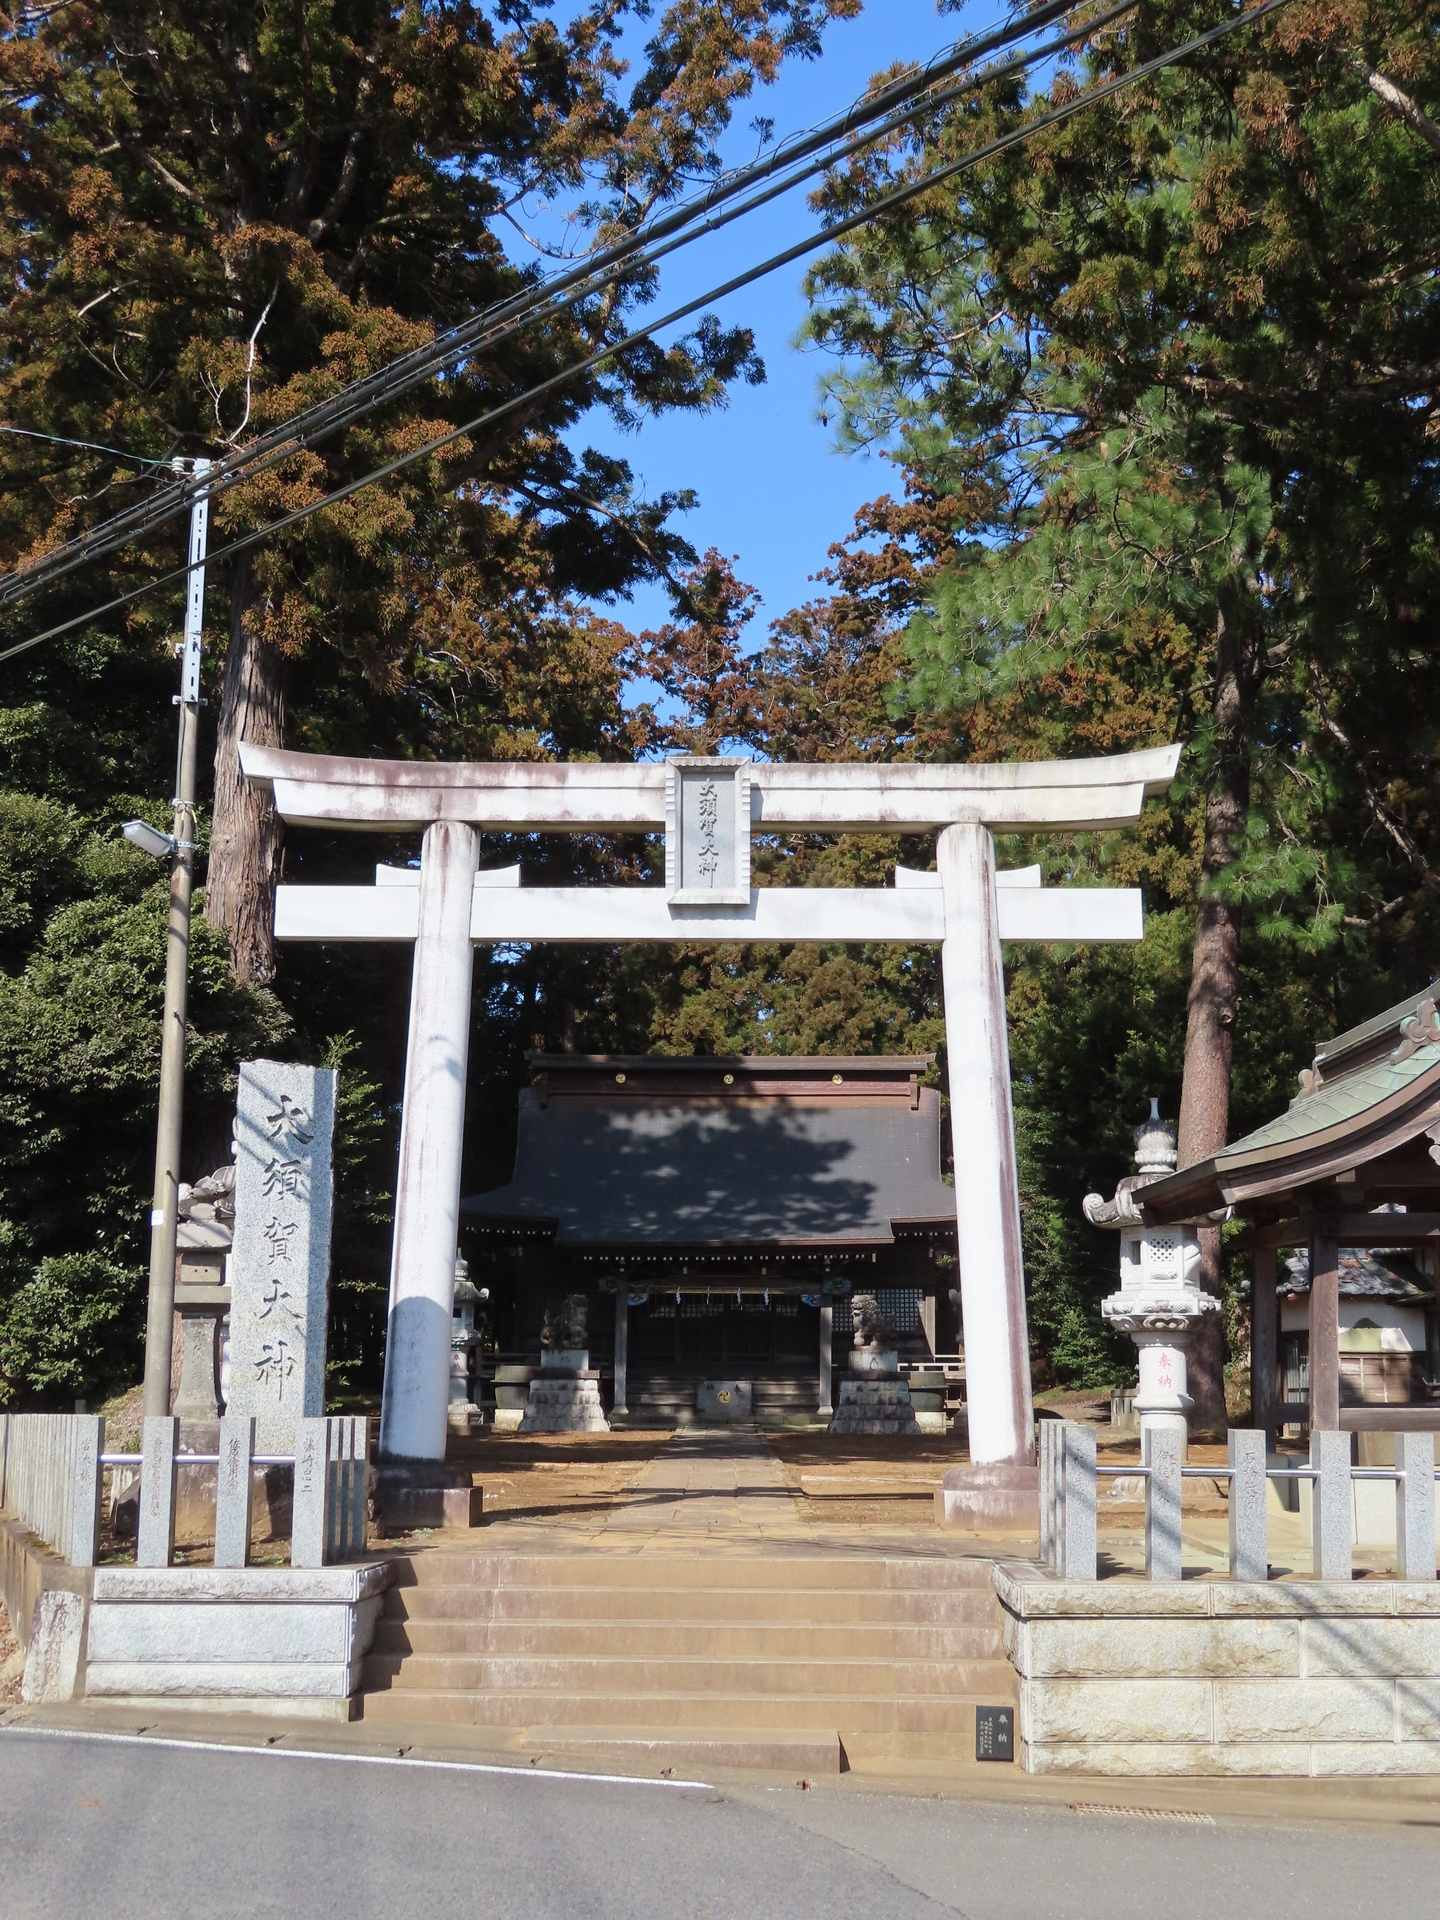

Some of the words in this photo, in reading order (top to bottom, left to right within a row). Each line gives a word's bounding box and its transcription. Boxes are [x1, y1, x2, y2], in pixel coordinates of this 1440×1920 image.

[698, 777, 719, 889] 大須賀大神
[253, 1094, 314, 1401] 大須賀大神
[1158, 1352, 1172, 1388] 奉納
[998, 1713, 1008, 1743] 奉納
